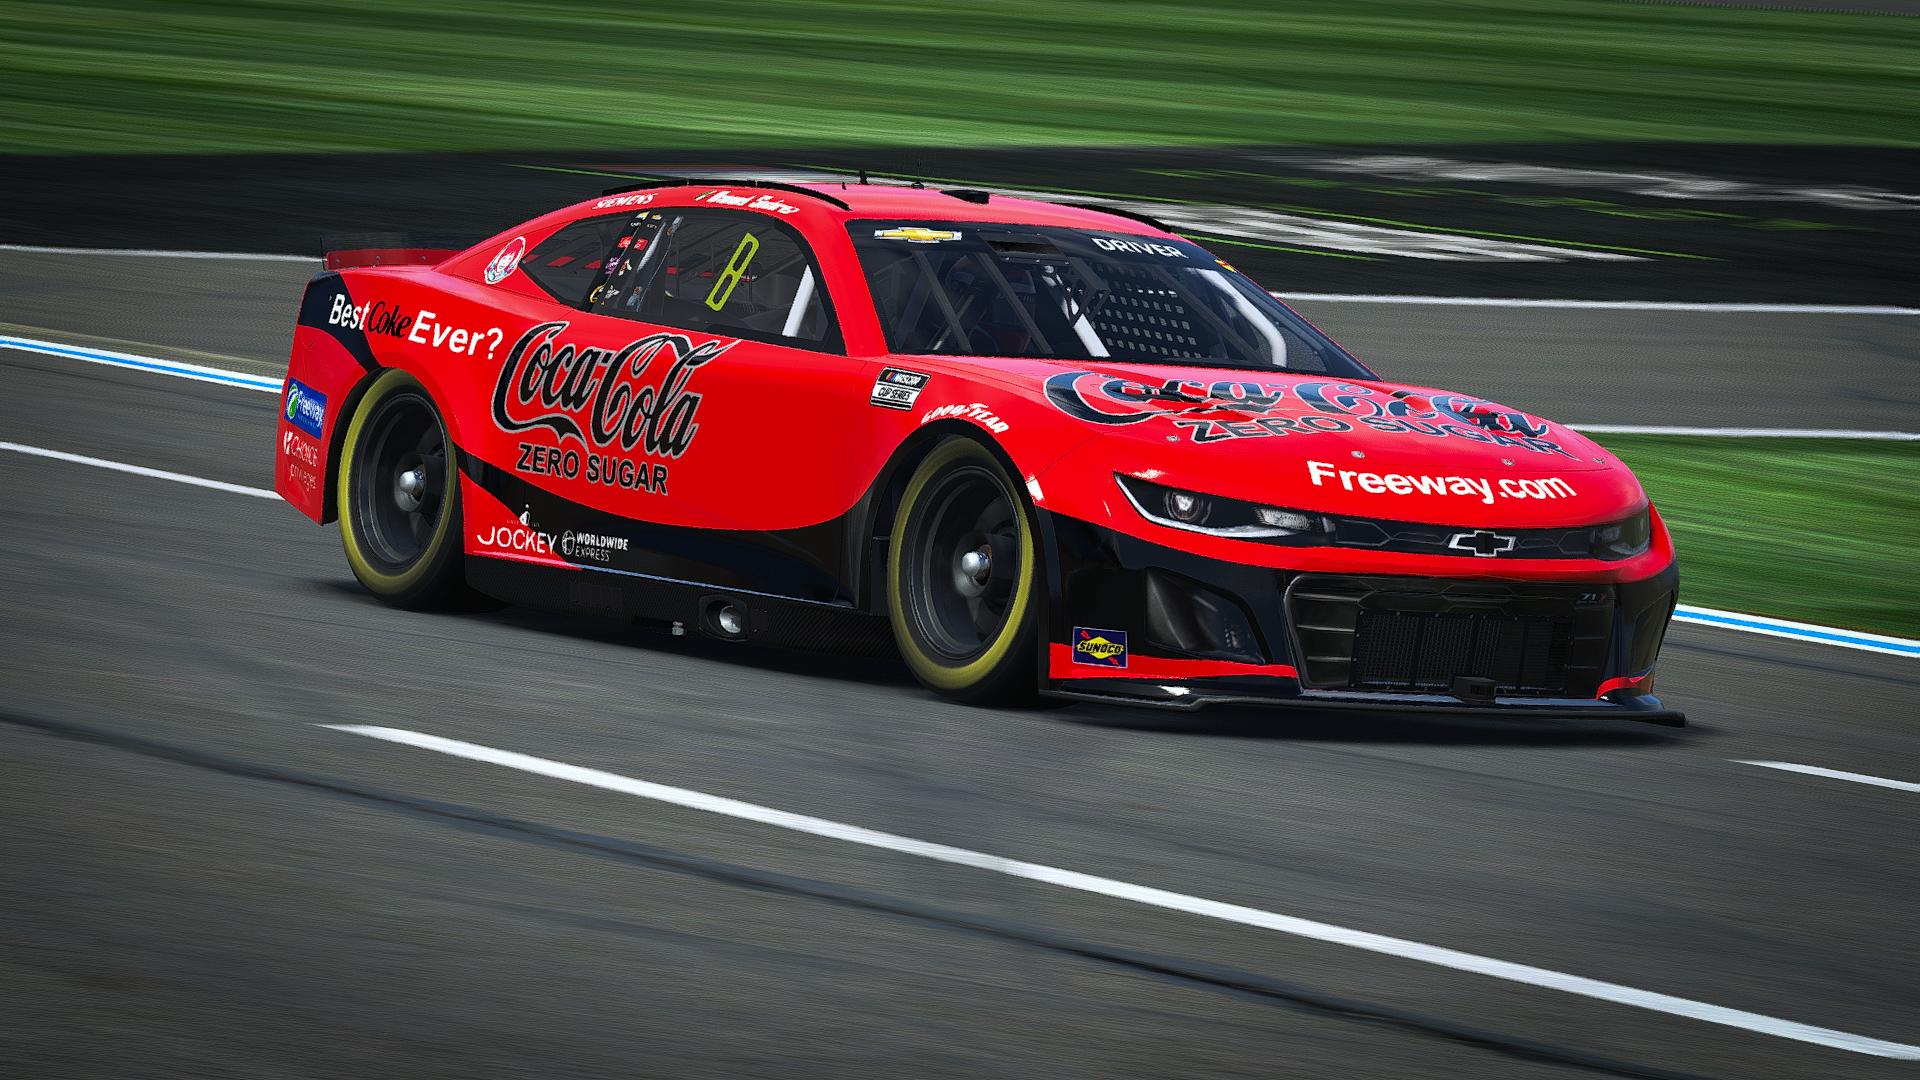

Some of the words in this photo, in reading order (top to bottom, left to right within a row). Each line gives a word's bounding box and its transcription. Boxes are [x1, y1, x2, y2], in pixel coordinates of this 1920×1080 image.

[592, 193, 659, 210] SIEMENS
[1091, 238, 1189, 259] DRIVER
[328, 293, 370, 331] Best
[368, 301, 411, 338] Coke
[408, 309, 503, 360] Ever?
[491, 321, 741, 459] Coca-Cola
[1172, 416, 1354, 444] ZERO
[1356, 415, 1582, 461] SUGAR
[515, 443, 580, 480] ZERO
[586, 452, 668, 496] SUGAR
[1306, 460, 1578, 504] Freeway.com
[476, 526, 558, 555] JOCKEY
[575, 547, 611, 562] EXPRESS
[576, 532, 629, 550] WORLDWIDE
[1078, 641, 1122, 654] SUNOCO
